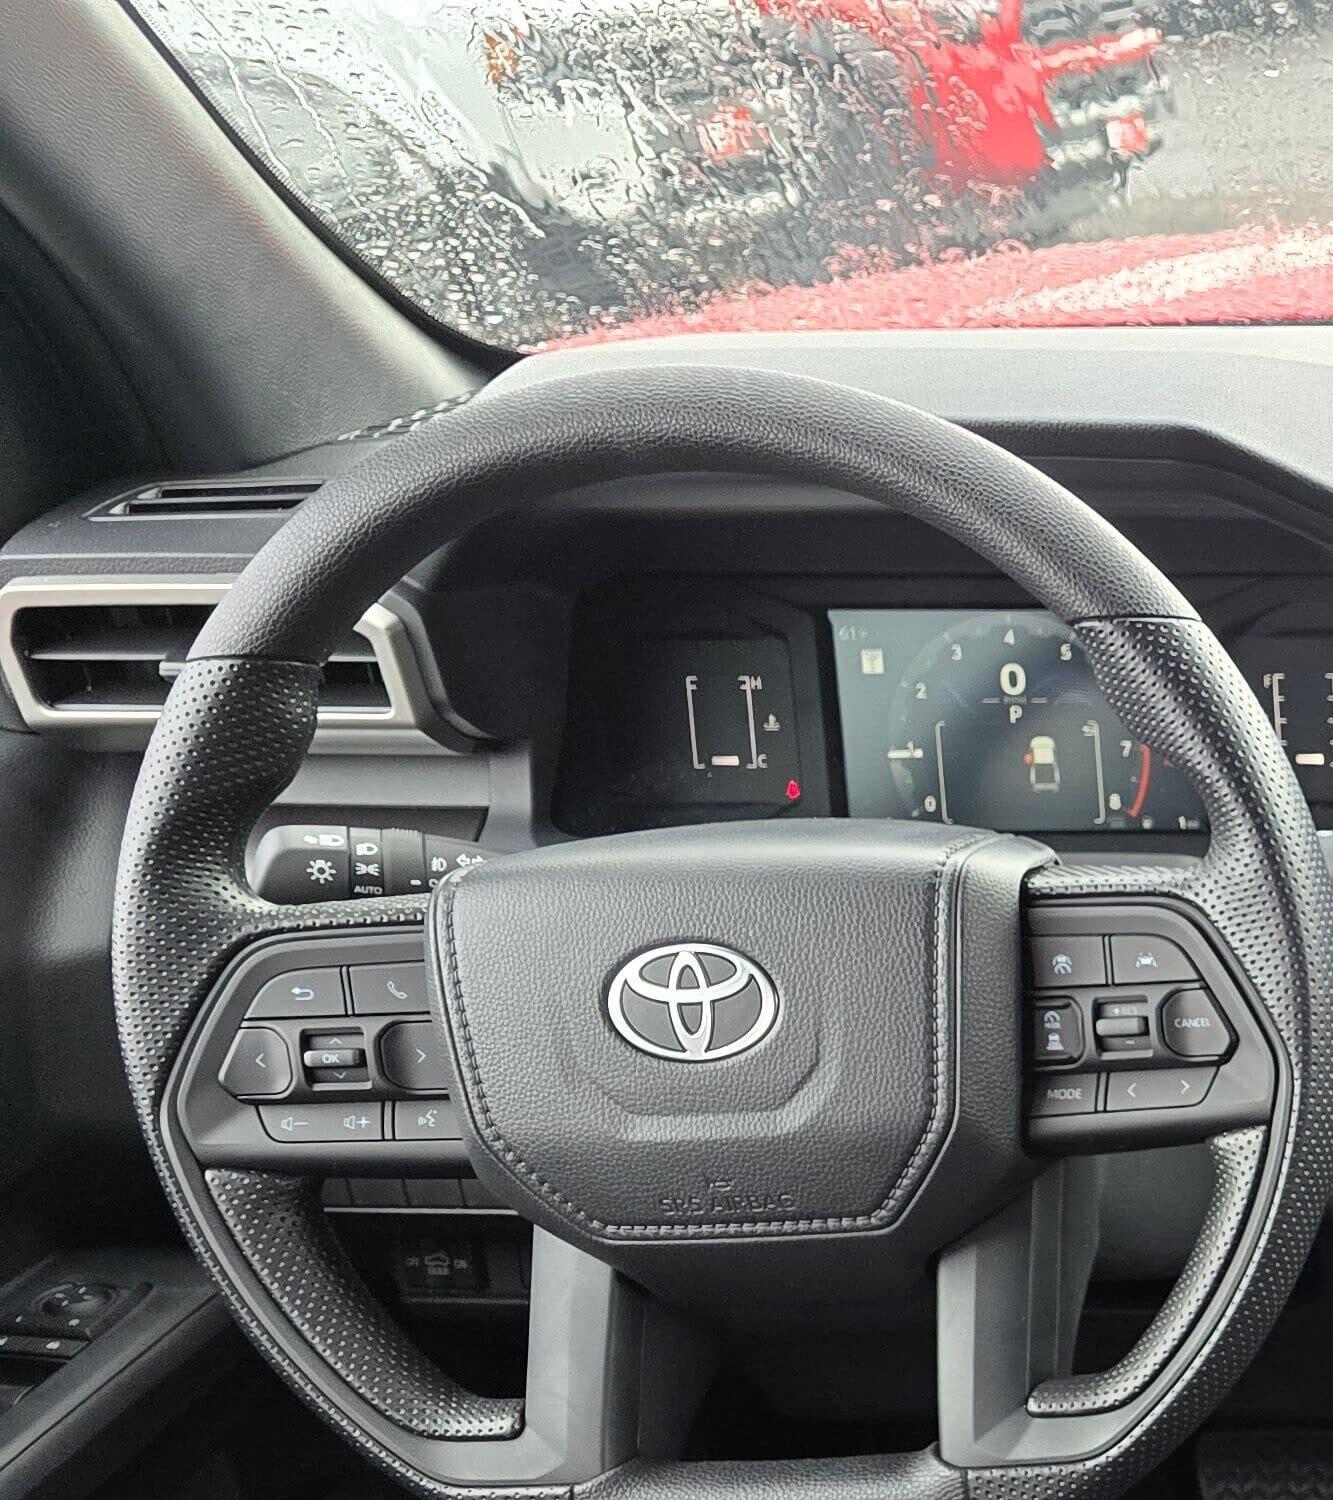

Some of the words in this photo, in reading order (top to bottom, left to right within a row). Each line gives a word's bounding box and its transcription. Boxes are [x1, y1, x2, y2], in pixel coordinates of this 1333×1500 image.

[1003, 629, 1015, 646] 4
[951, 644, 963, 661] 3
[1060, 643, 1072, 661] 5
[999, 662, 1027, 696] 0
[915, 682, 928, 699] 2
[1009, 705, 1023, 724] P
[1120, 740, 1132, 758] 7
[757, 753, 769, 769] C
[353, 884, 383, 896] AUTO
[1174, 1017, 1211, 1029] CANCEL
[321, 1053, 341, 1065] OK
[1046, 1088, 1083, 1100] MODE
